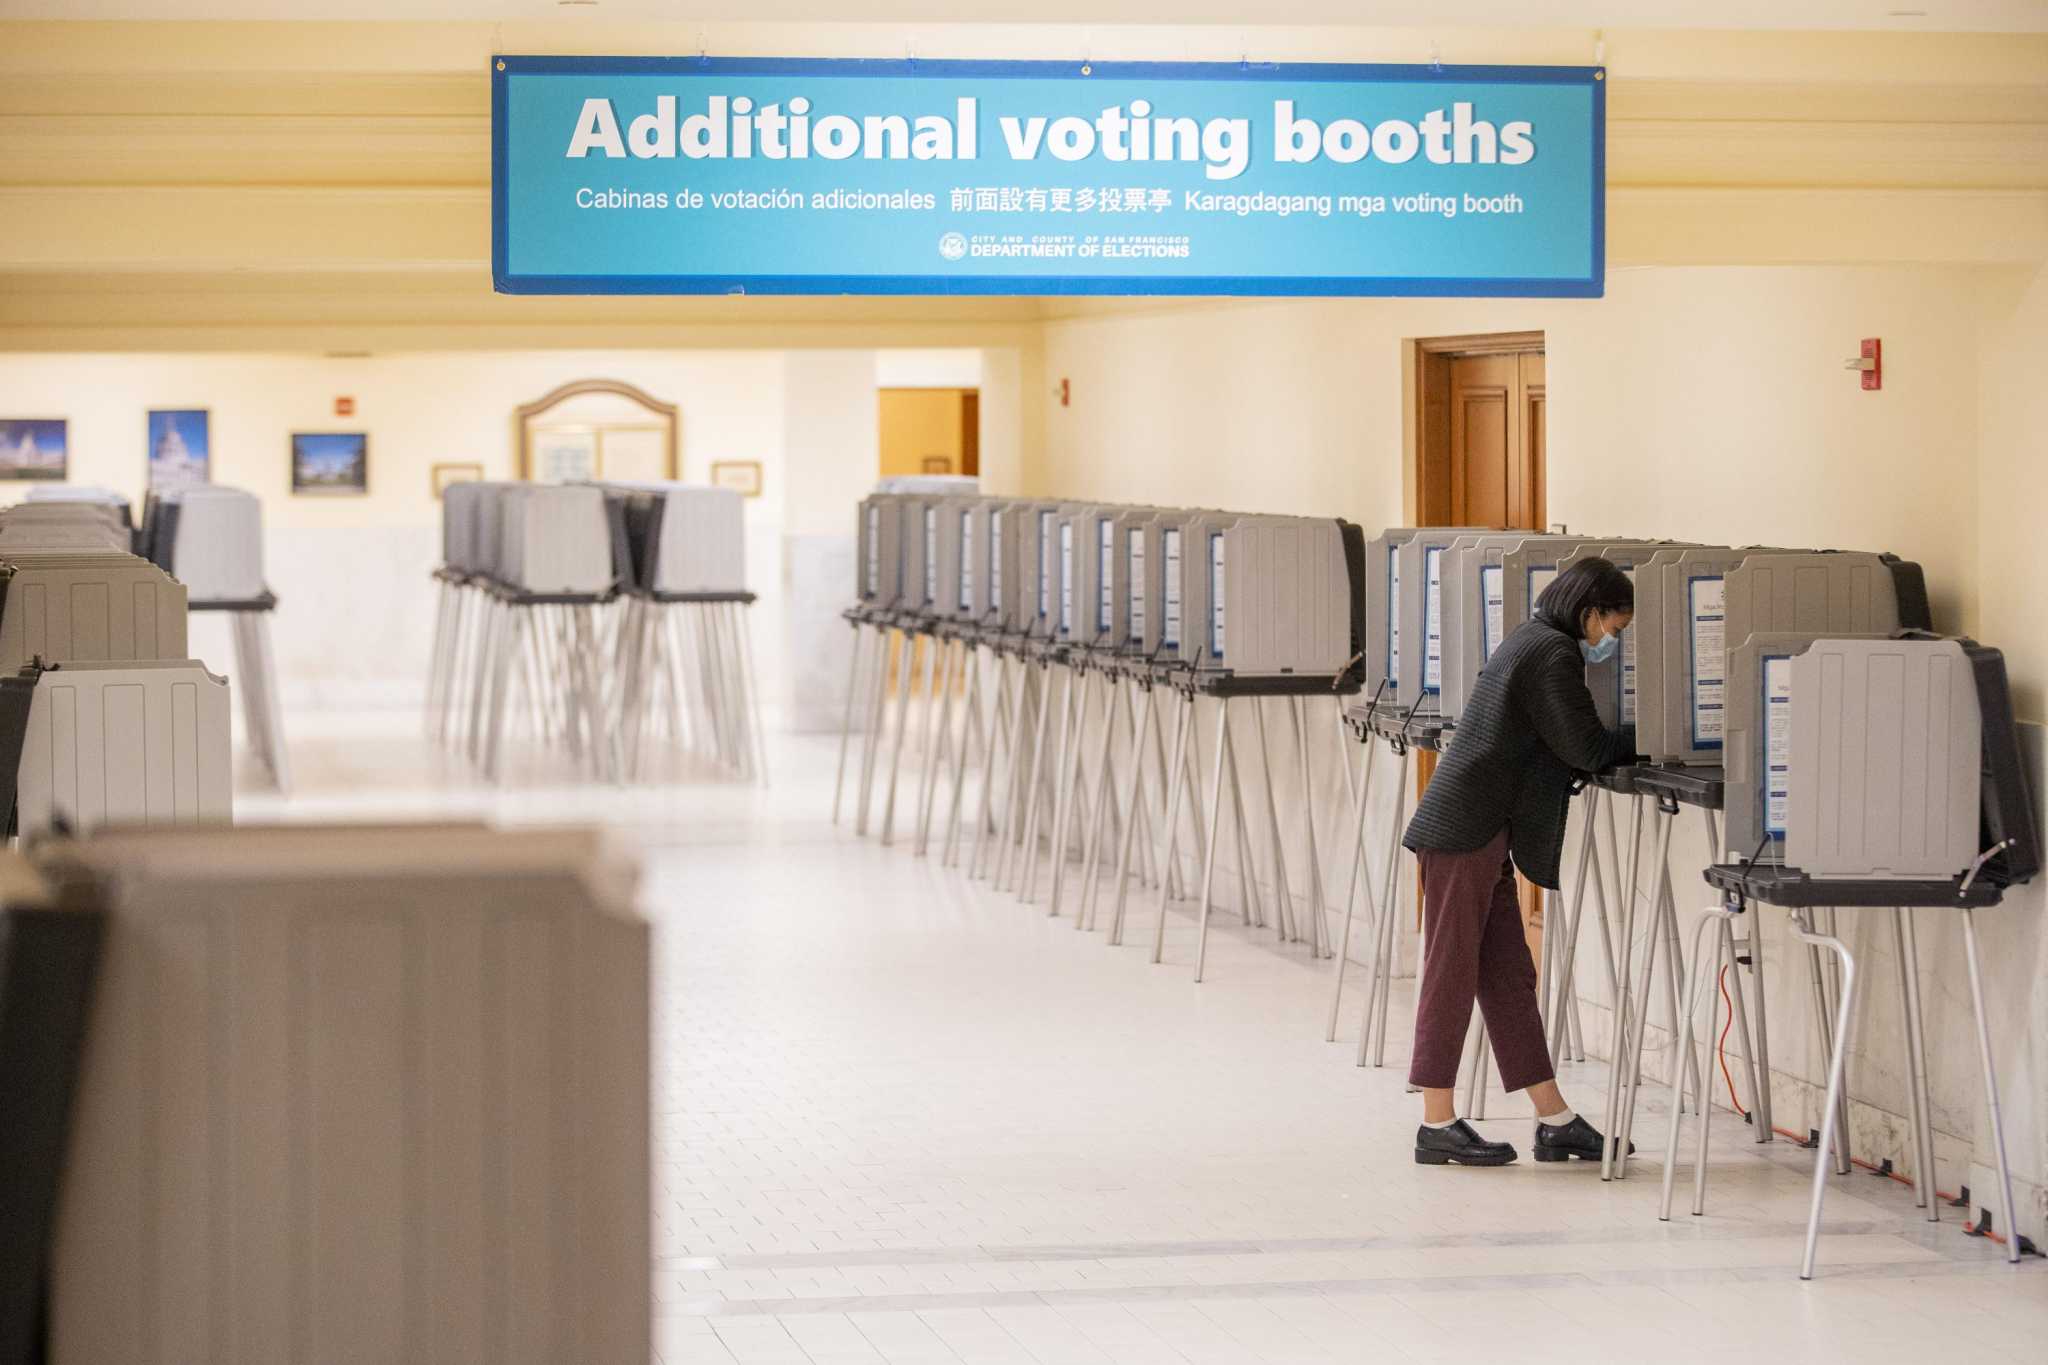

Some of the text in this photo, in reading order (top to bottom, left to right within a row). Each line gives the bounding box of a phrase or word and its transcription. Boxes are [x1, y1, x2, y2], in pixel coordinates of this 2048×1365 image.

[566, 95, 1535, 180] Additional voting booths
[576, 188, 936, 210] Cabinas de votación adicionales
[950, 187, 1172, 213] 前面設有更多投票亭
[1184, 191, 1524, 218] Karagdagang mga voting booth
[971, 235, 1190, 244] CITY AND COUNTY OF SAN FRANCISCO
[971, 244, 1190, 258] DEPARTMENT OF ELECTIONS
